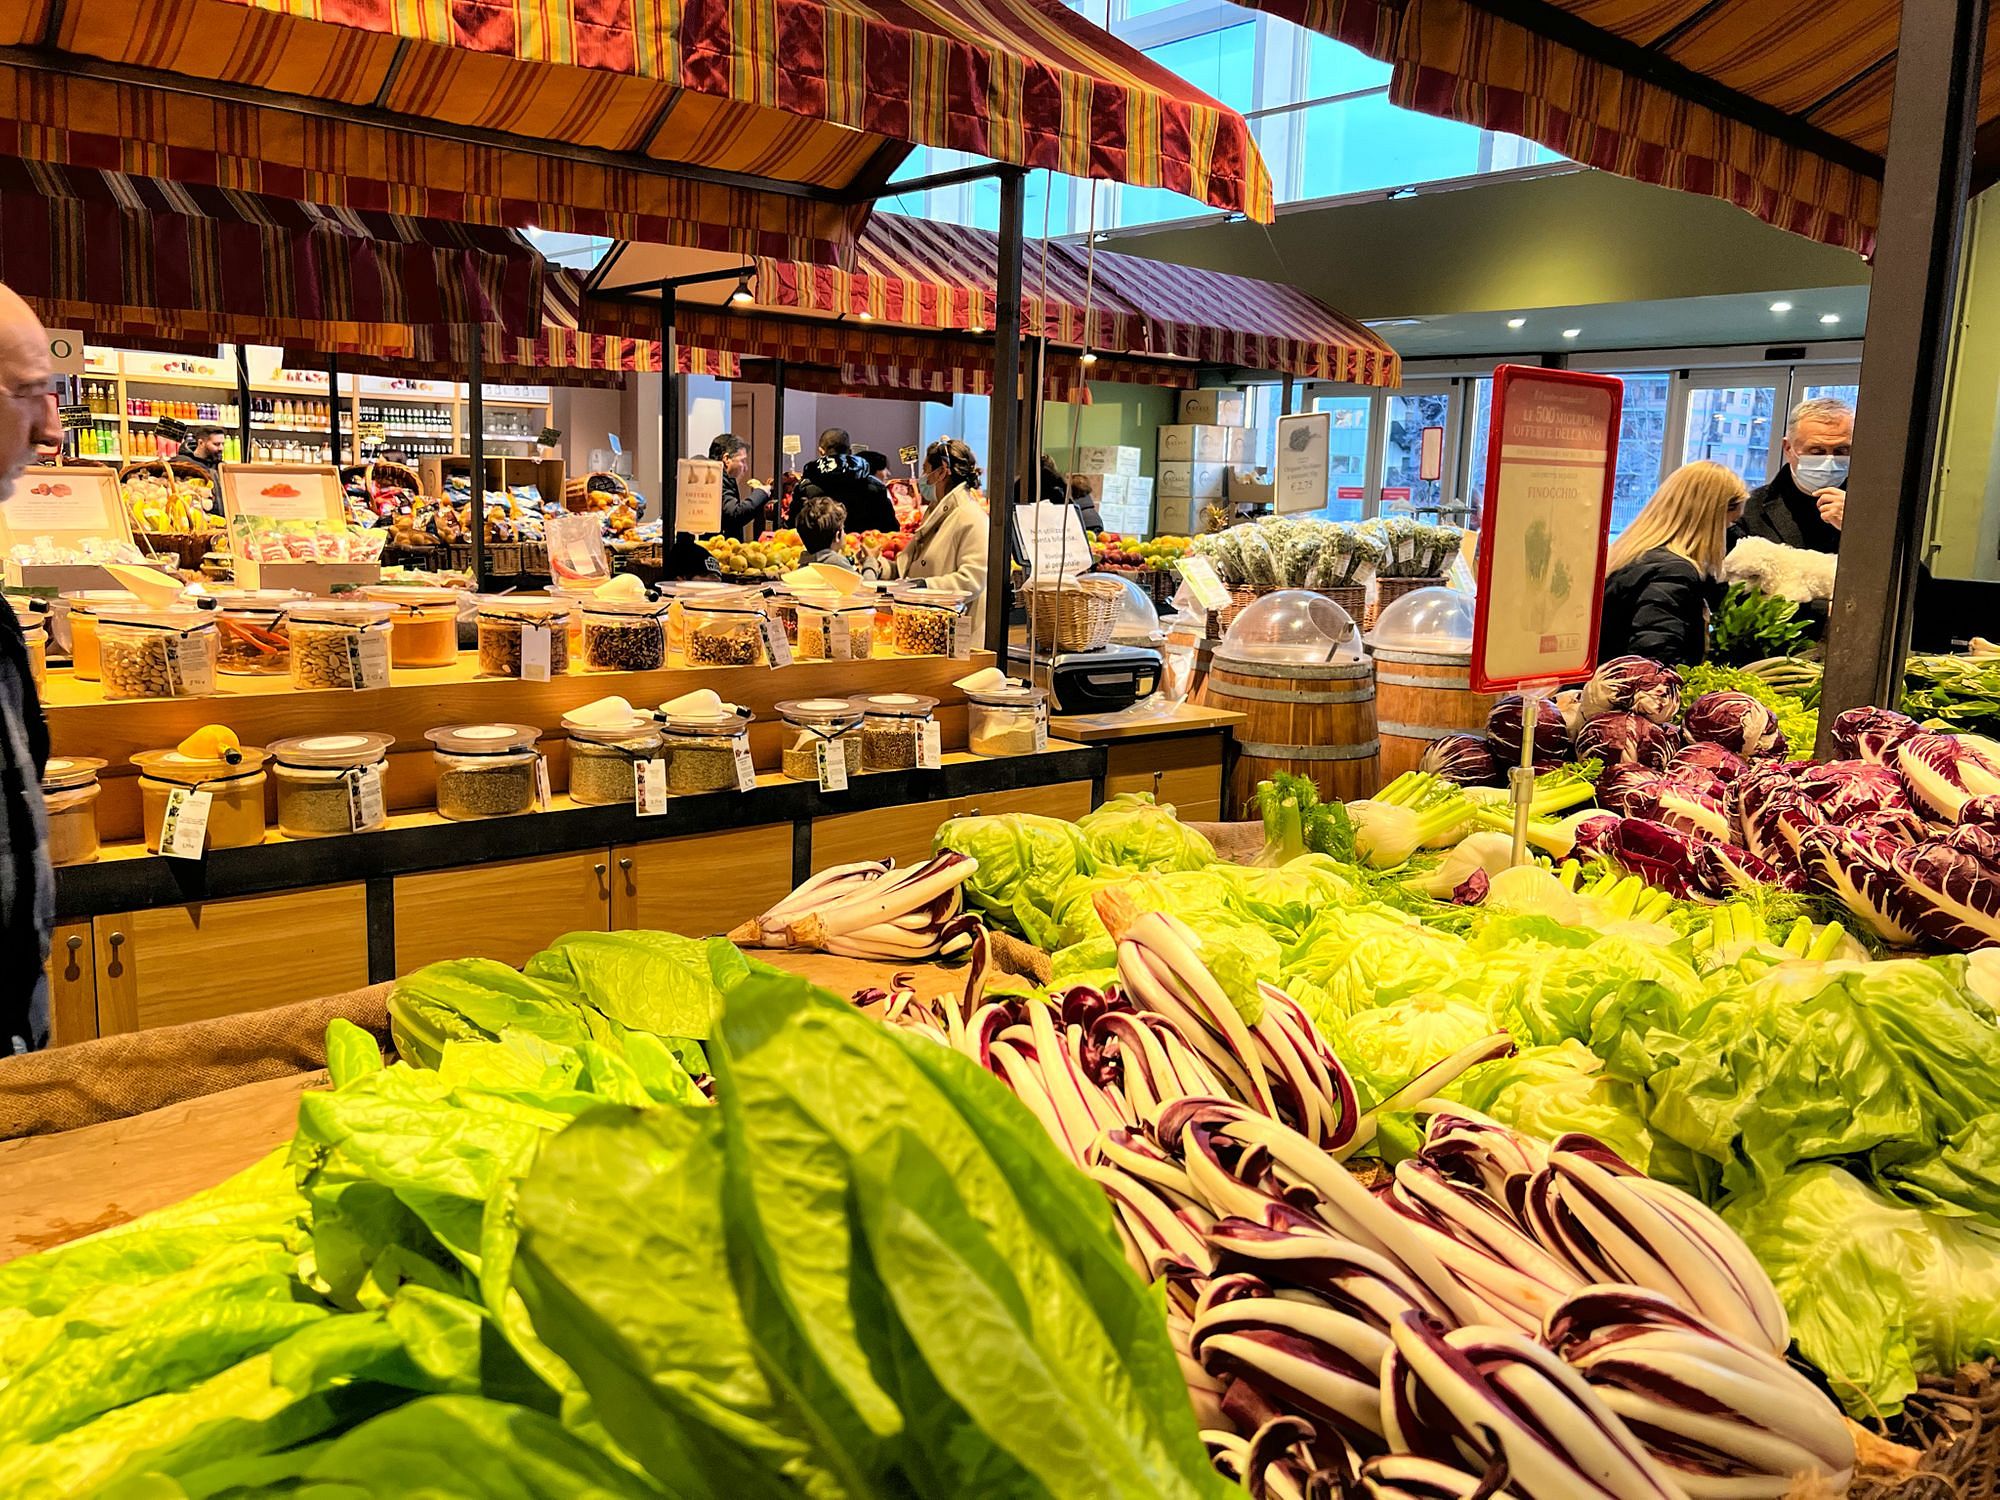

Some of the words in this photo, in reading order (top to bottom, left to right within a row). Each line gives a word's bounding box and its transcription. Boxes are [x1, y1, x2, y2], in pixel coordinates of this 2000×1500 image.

[1535, 406, 1555, 423] 500
[1556, 413, 1595, 426] MIGLIORI
[1513, 424, 1553, 439] OFFERTE
[1528, 487, 1577, 499] FINOCCHIO
